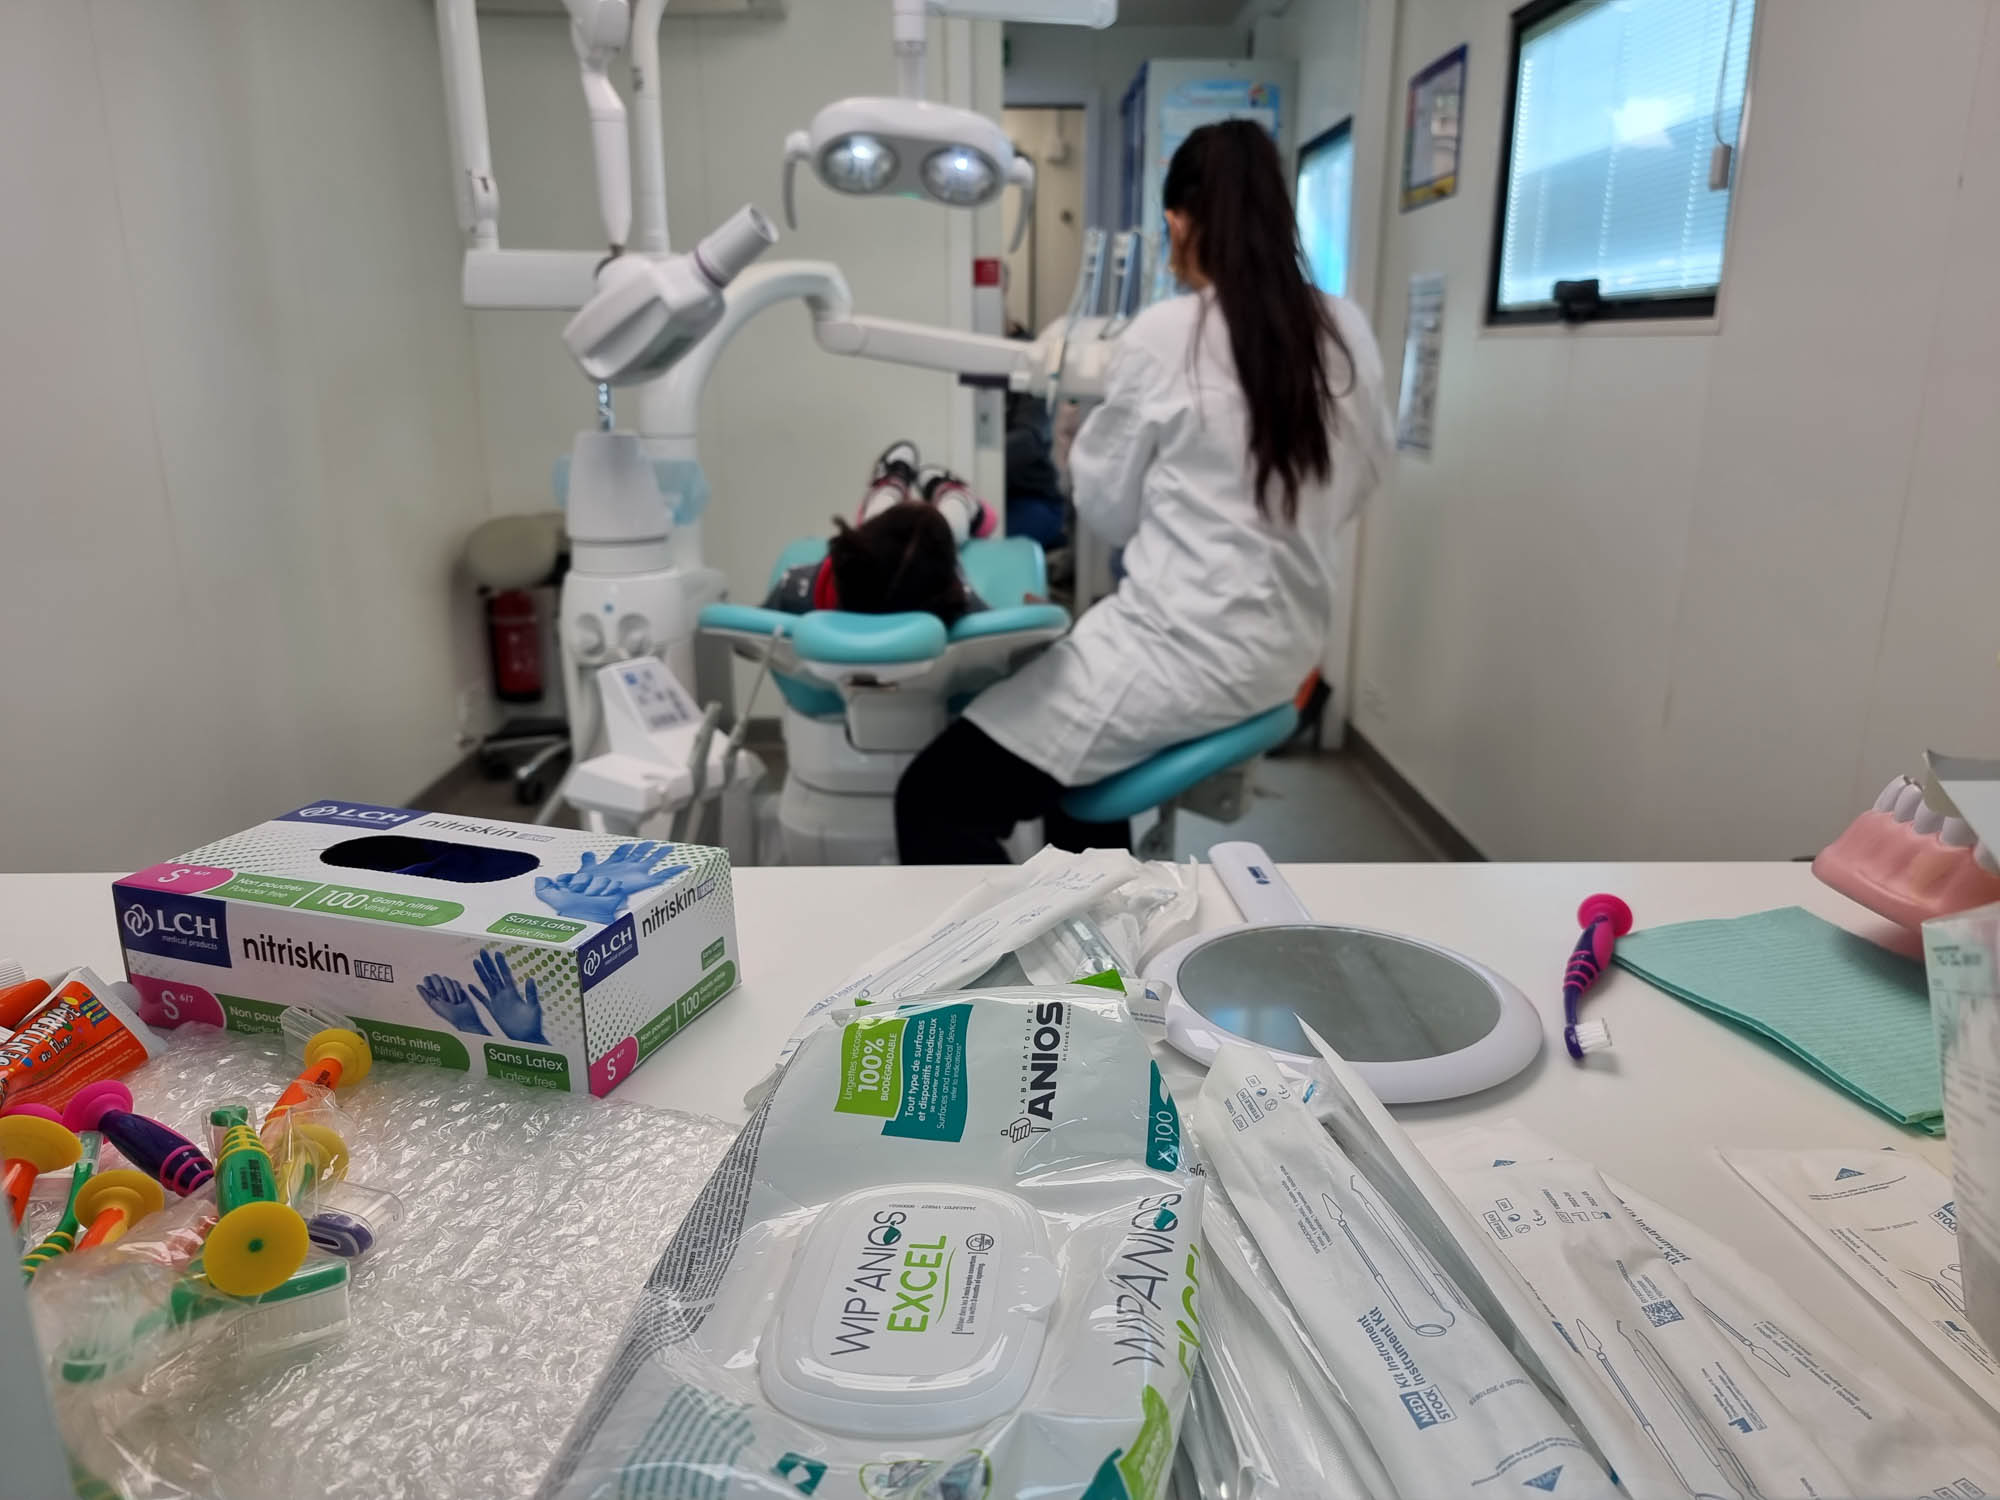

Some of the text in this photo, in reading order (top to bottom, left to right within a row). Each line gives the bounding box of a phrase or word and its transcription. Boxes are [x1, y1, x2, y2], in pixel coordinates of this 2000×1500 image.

[344, 808, 411, 822] LCH
[419, 817, 518, 838] nitriskin
[158, 868, 190, 883] S
[318, 890, 370, 909] 100
[372, 895, 439, 912] Gants nitrile
[391, 908, 426, 920] gloves
[642, 886, 697, 938] nitriskin
[158, 909, 219, 939] LCH
[505, 914, 580, 933] Sans Latex
[162, 934, 218, 950] medical products
[243, 933, 350, 975] nitriskin
[601, 926, 633, 959] LCH
[161, 990, 180, 1020] S
[229, 1006, 252, 1019] Non
[682, 991, 700, 1018] 100
[372, 1031, 441, 1052] Gants nitrile
[489, 1048, 564, 1071] Sans Latex
[606, 1058, 616, 1081] S
[857, 1038, 885, 1092] 100%
[880, 1033, 897, 1101] BIODÉGRADABLE
[905, 1020, 925, 1117] Tout type de surfaces
[918, 1018, 938, 1122] et dispositifs médicaux
[936, 1014, 957, 1129] Surfaces and medical devices
[1028, 1001, 1064, 1121] ANIOS
[501, 1069, 557, 1089] Latex free
[843, 1061, 858, 1100] Lingettes
[931, 1078, 939, 1105] reporter
[930, 1105, 936, 1113] se
[1155, 1111, 1174, 1143] 100
[1636, 1219, 1691, 1262] Instrument
[1663, 1251, 1682, 1266] Kit
[830, 1211, 907, 1355] WIP'ANIOS
[887, 1235, 947, 1332] EXCEL
[1357, 1315, 1412, 1389] Kit Instrument
[1369, 1306, 1426, 1386] Instrument Kit
[1405, 1395, 1433, 1421] MEDI
[1424, 1389, 1451, 1420] STOCK
